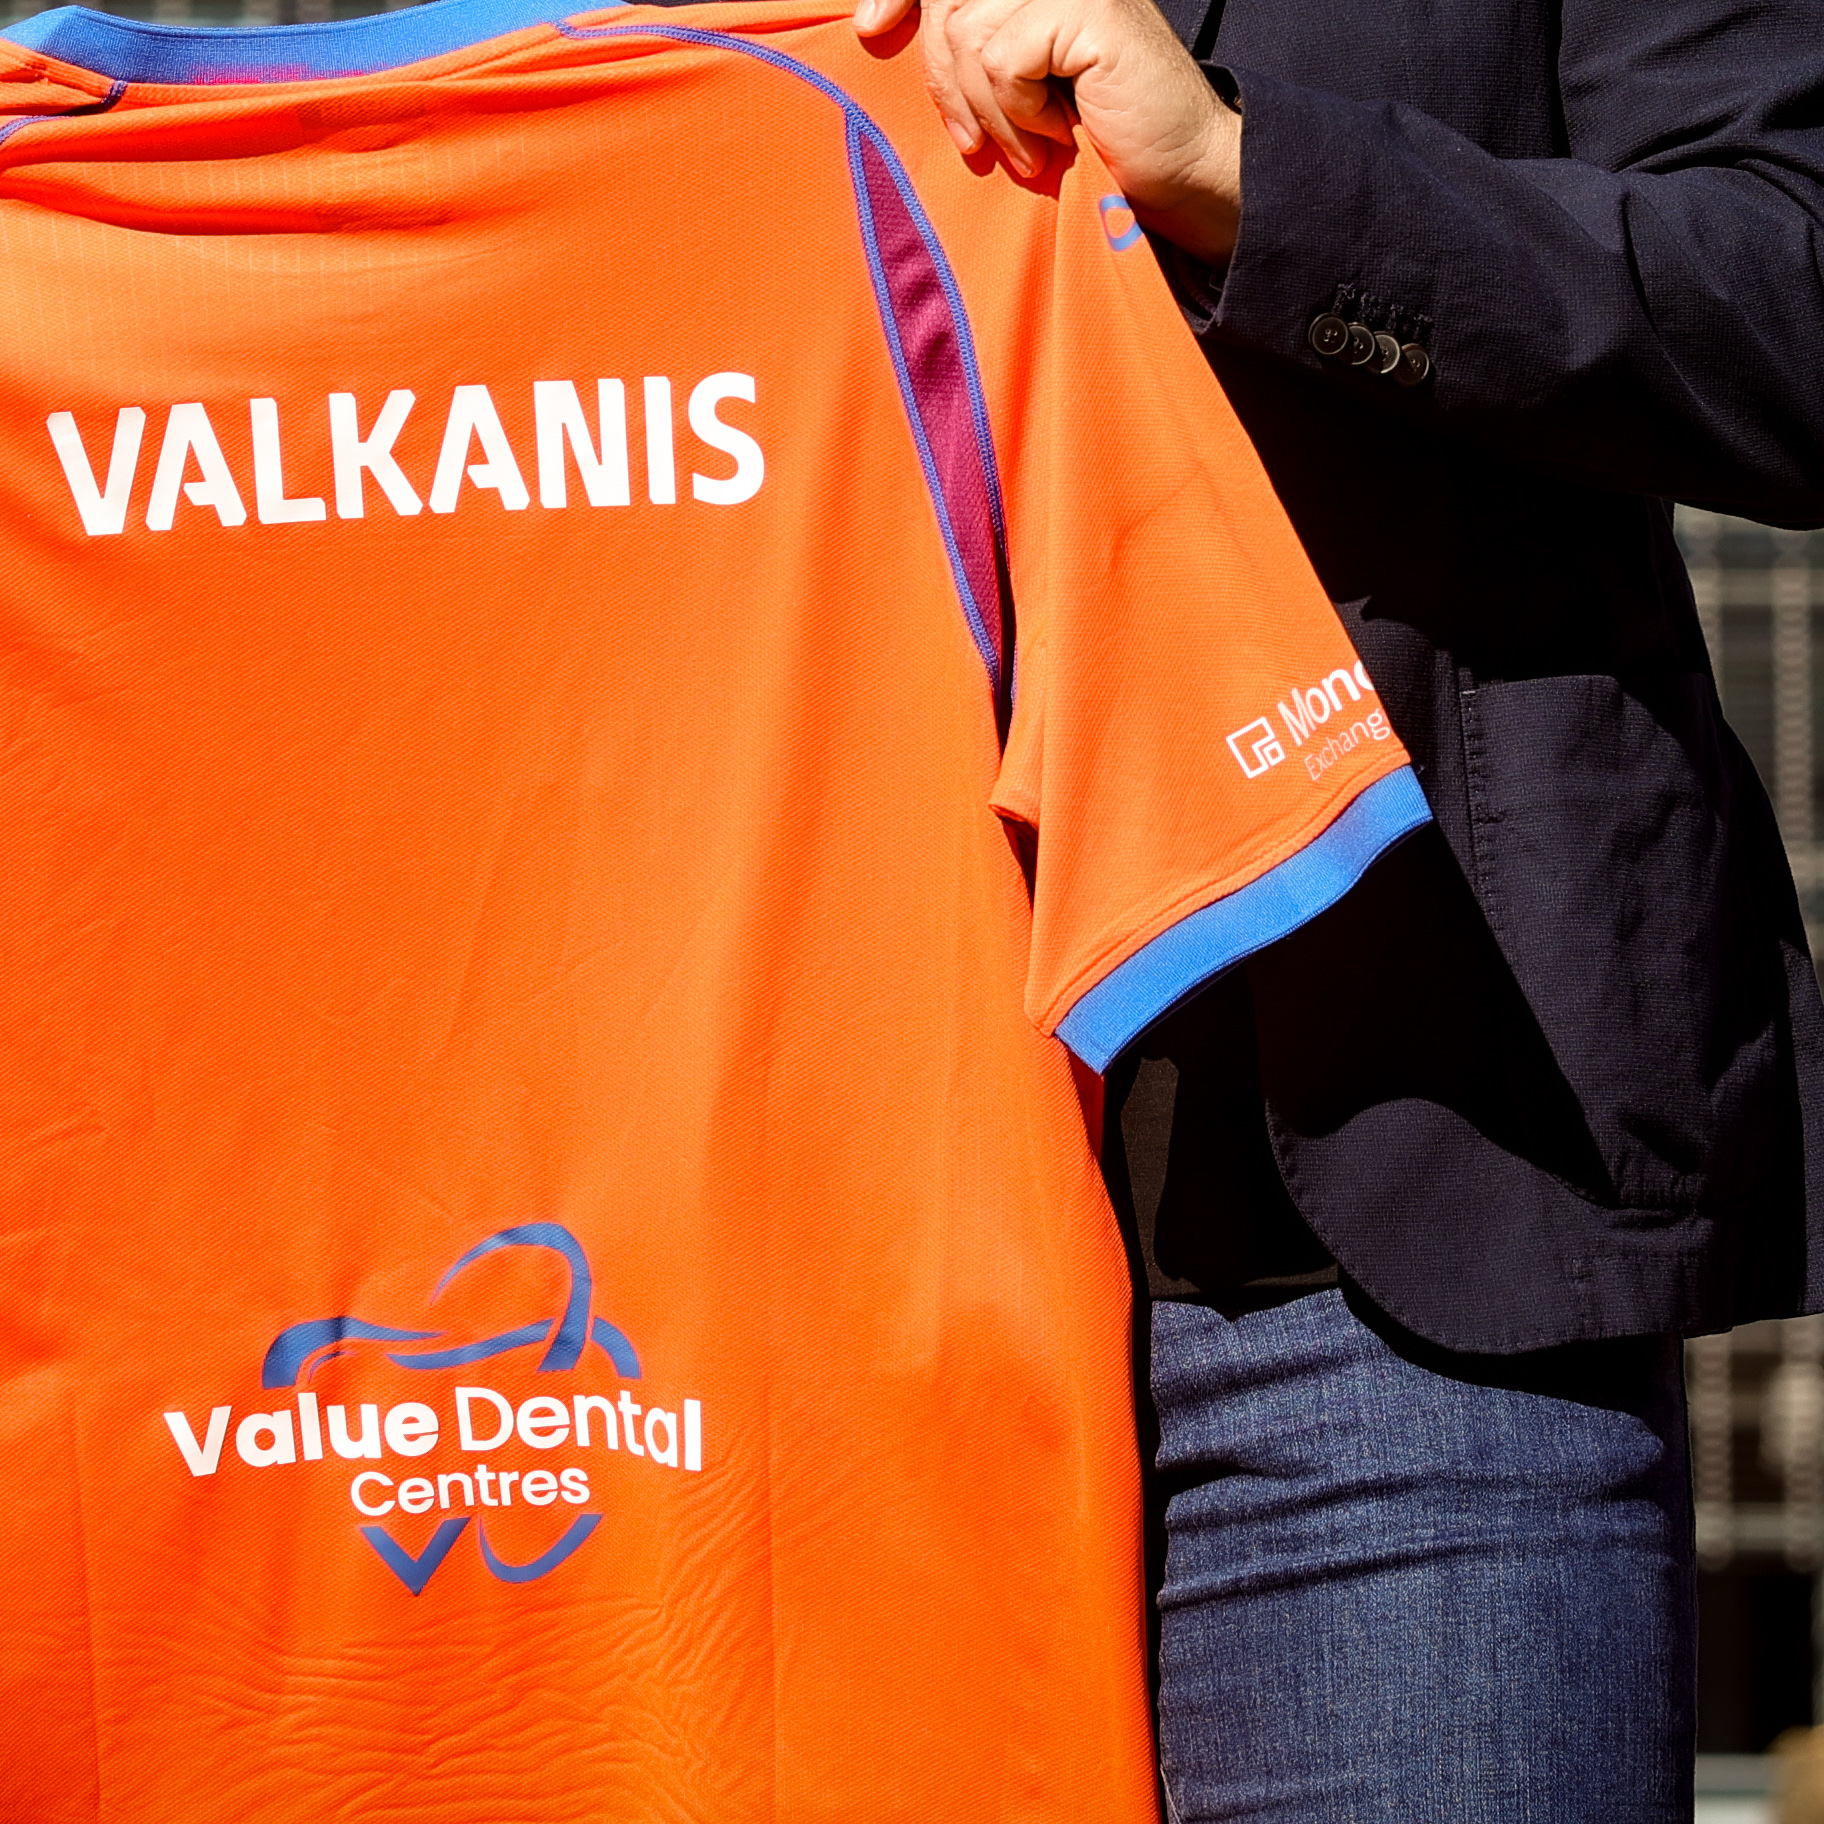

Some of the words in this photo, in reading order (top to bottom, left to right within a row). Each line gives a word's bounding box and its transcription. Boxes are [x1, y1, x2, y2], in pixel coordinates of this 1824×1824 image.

[45, 370, 766, 537] VALKANIS
[1302, 707, 1391, 782] Exchang
[162, 1391, 440, 1478] Value
[454, 1386, 703, 1473] Dental
[349, 1464, 592, 1518] Centres
